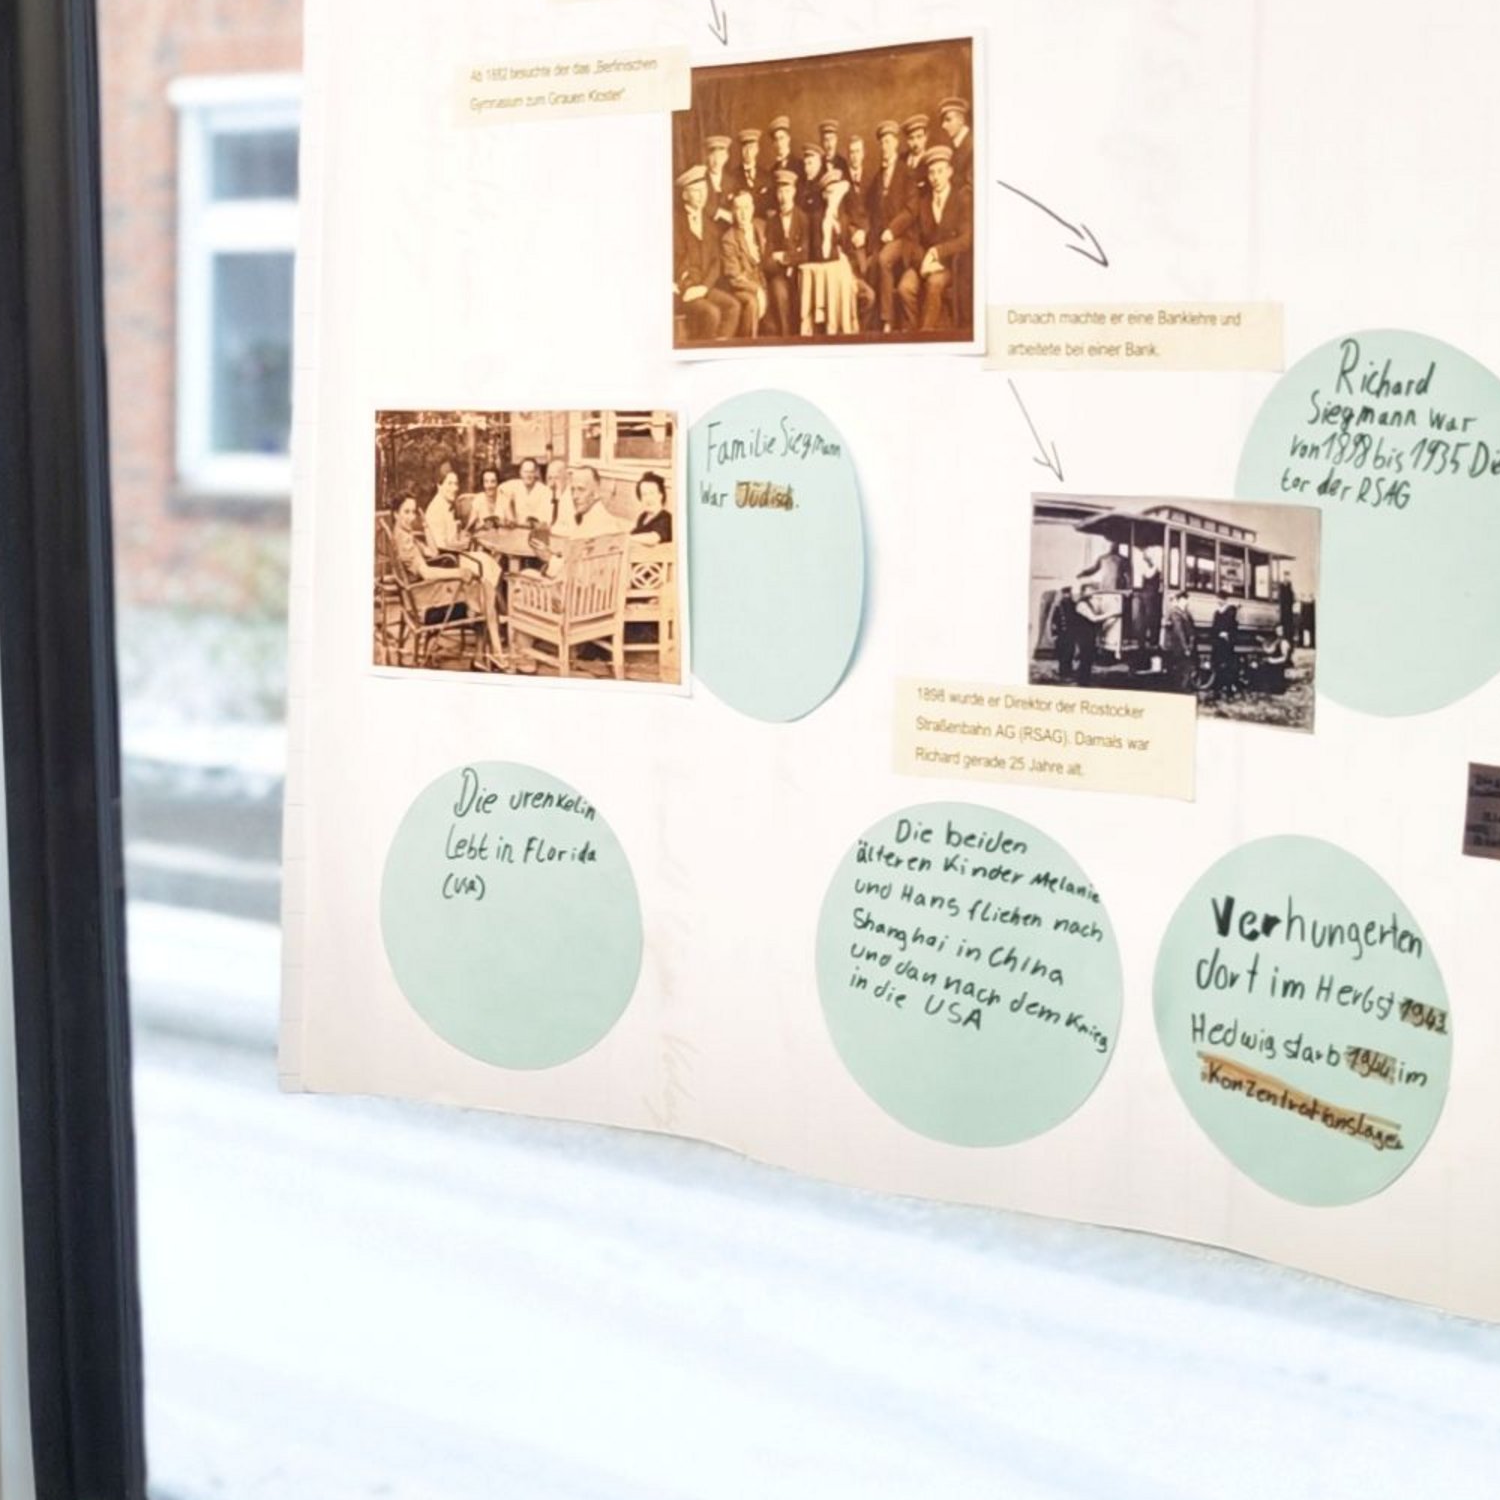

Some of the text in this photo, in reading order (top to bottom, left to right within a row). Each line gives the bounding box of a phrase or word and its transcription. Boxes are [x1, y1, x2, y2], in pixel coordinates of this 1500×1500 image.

[549, 91, 585, 105] Grauen
[1007, 310, 1241, 326] Danach machte er eine Banklehre und
[1007, 342, 1061, 356] arbeitete
[1065, 342, 1084, 356] bei
[1087, 343, 1120, 356] einer
[1335, 339, 1436, 397] Richard
[1307, 390, 1417, 430] Siegmann
[707, 421, 776, 472] Familie
[1372, 441, 1404, 474] bis
[1316, 467, 1352, 501] der
[1357, 476, 1411, 509] RSAG
[950, 691, 984, 706] wurde
[987, 695, 1001, 707] er
[1005, 695, 1052, 712] Direktor
[1056, 699, 1076, 714] der
[1080, 700, 1145, 719] Rostocker
[916, 716, 991, 738] Straßenbahn
[995, 725, 1016, 739] AG
[1075, 732, 1123, 750] Damals
[1128, 738, 1150, 752] war
[915, 747, 960, 765] Richard
[964, 753, 1006, 770] gerade
[1009, 756, 1025, 771] 25
[1029, 757, 1064, 775] Jahre
[454, 767, 498, 817] Die
[496, 836, 514, 863] in
[895, 818, 1028, 855] Die beiden
[856, 838, 1100, 903] älteren Kinder Melanie
[854, 877, 893, 900] und
[901, 884, 960, 917] Hans
[1053, 916, 1104, 942] nach
[1211, 895, 1423, 960] Verhungerten
[853, 907, 1065, 987] Shanghai in China
[850, 942, 893, 967] und
[943, 976, 1001, 1006] nach
[1009, 991, 1061, 1024] dem
[1195, 948, 1260, 993] dort
[1271, 966, 1305, 999] im
[850, 965, 982, 1031] in die USA
[1191, 1012, 1277, 1059] Hedwig
[1283, 1032, 1340, 1067] starb
[1399, 1062, 1428, 1087] im
